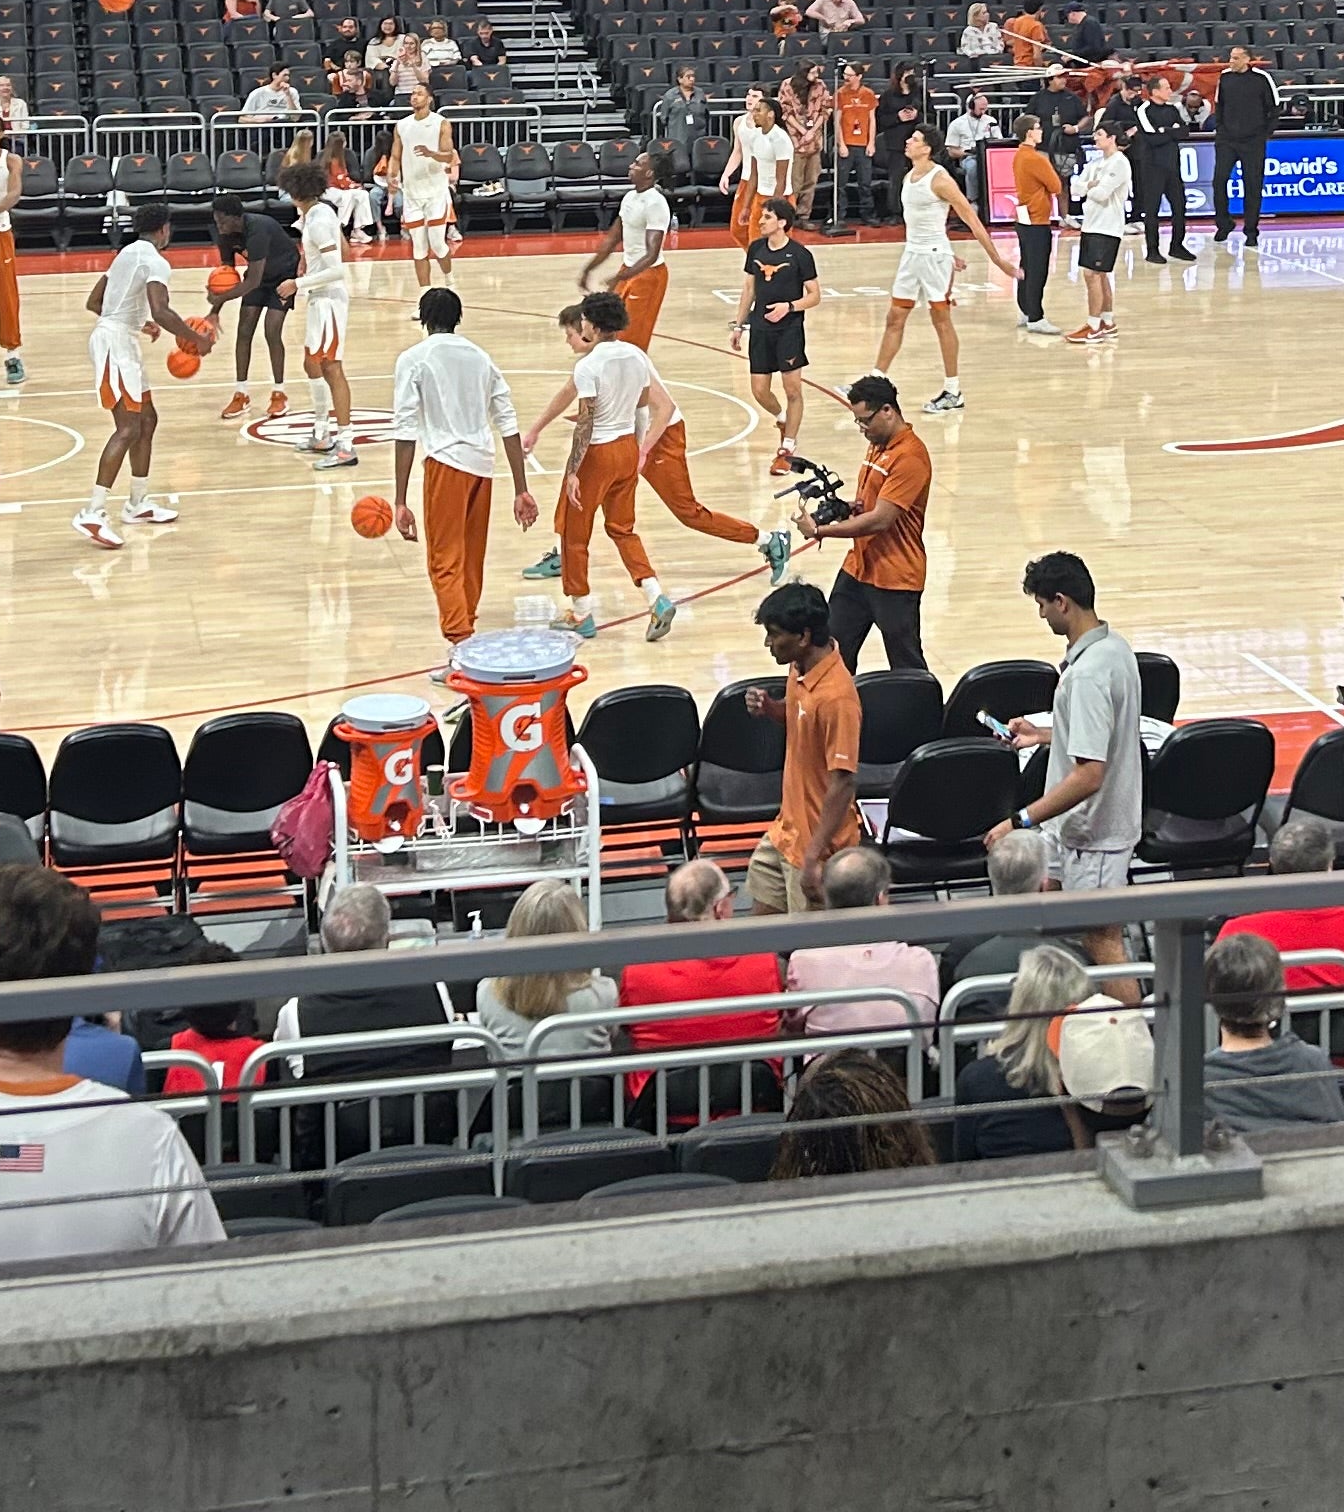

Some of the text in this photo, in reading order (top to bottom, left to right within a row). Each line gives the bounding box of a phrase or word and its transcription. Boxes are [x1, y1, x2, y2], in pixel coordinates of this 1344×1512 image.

[1180, 147, 1199, 182] 0
[1264, 157, 1338, 176] David's
[499, 701, 544, 752] G
[384, 747, 414, 784] G
